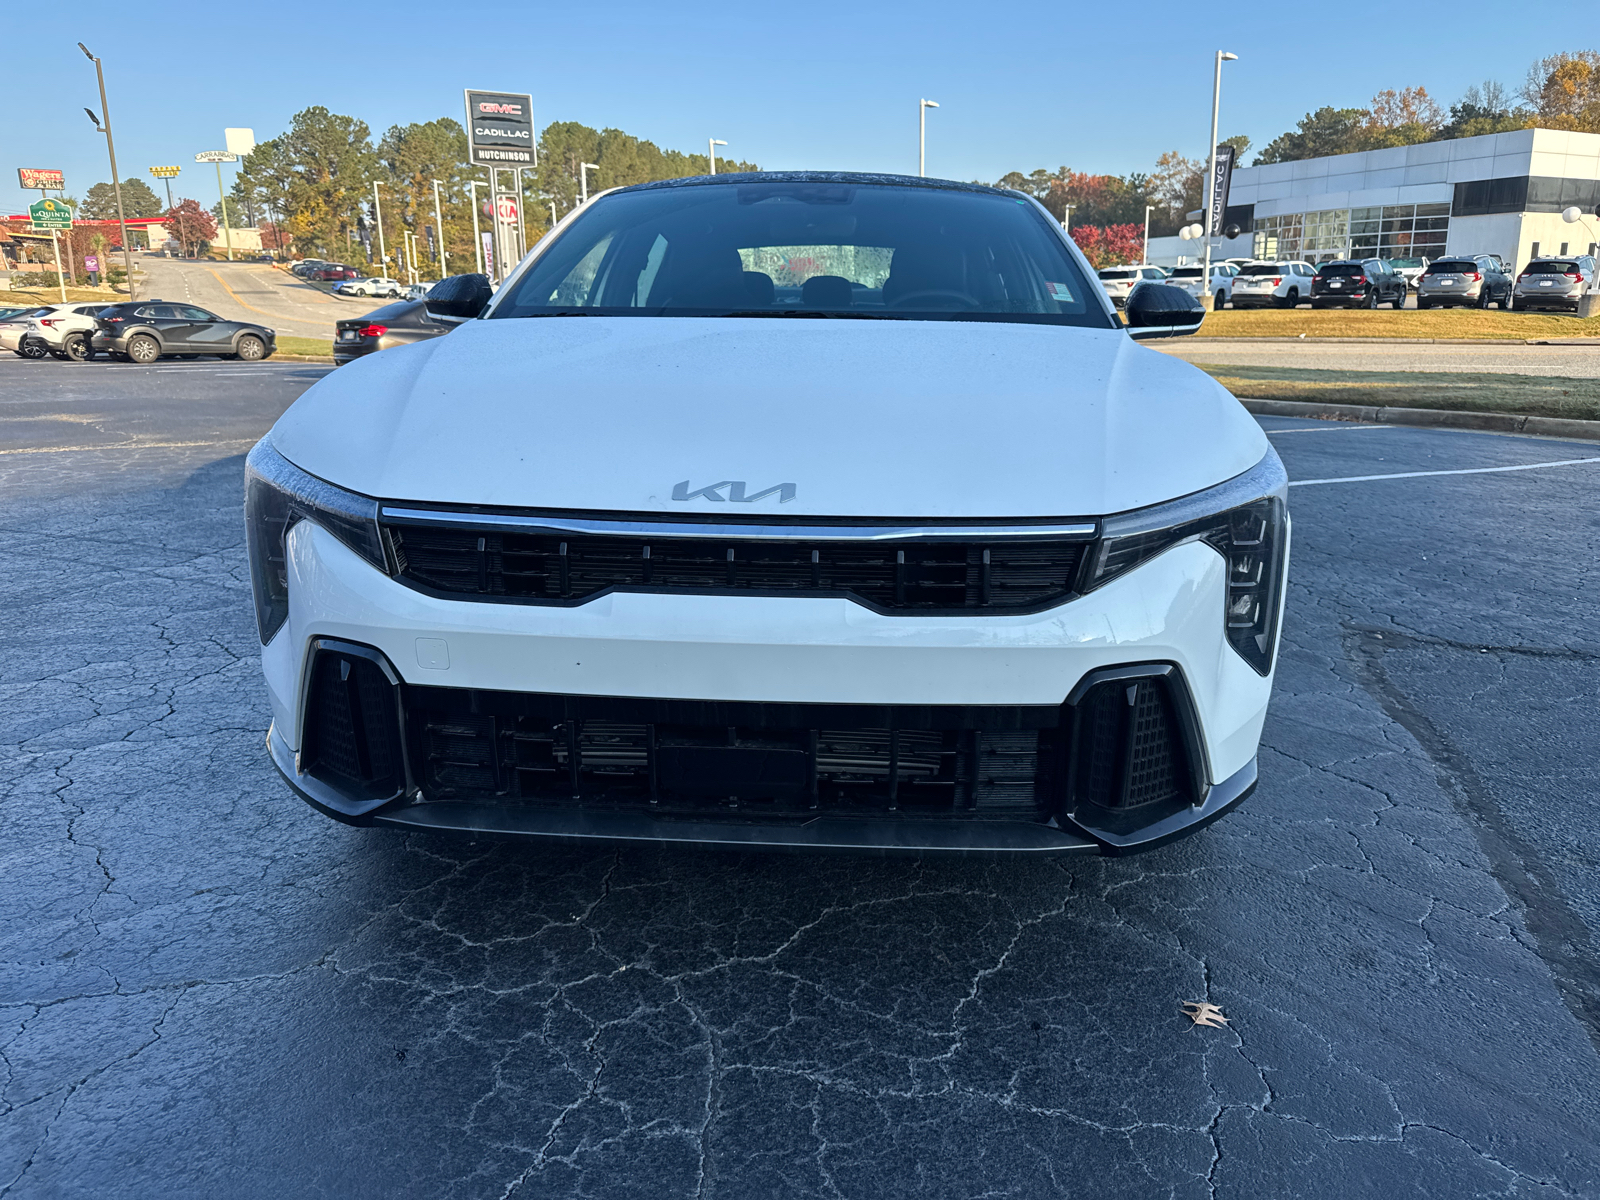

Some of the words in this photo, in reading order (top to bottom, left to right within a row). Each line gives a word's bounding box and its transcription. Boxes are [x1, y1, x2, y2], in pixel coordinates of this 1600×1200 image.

[480, 102, 522, 115] GMC
[475, 127, 530, 139] CADILLAC
[478, 149, 530, 162] HUTCHINSON
[39, 210, 70, 219] QUINTA
[671, 480, 797, 504] KIA
